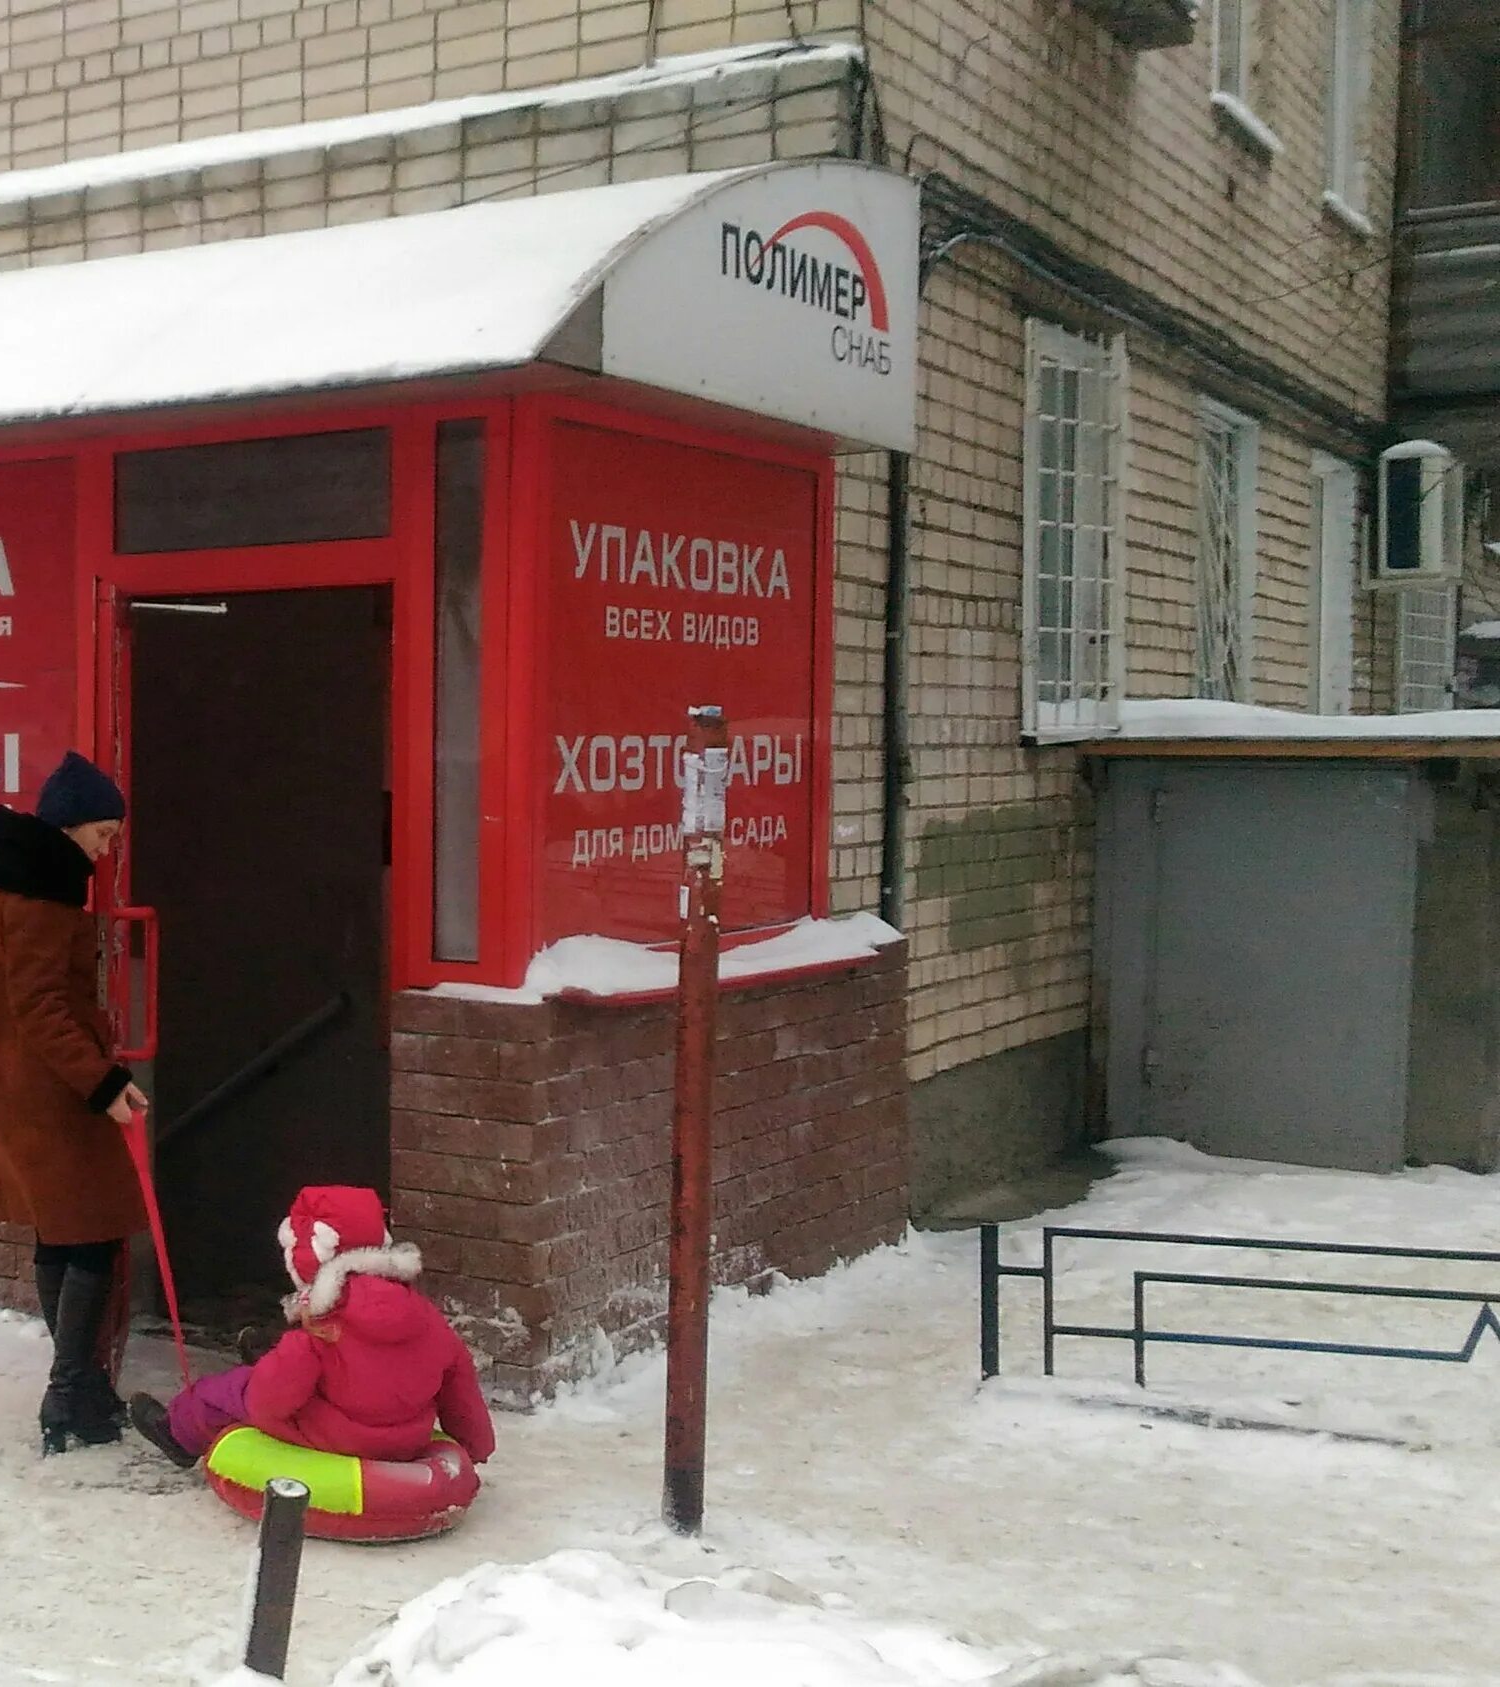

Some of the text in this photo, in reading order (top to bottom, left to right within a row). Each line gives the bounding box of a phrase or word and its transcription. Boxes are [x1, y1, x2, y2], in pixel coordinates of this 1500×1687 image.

[721, 221, 866, 321] ПОЛИМЕР
[831, 325, 892, 376] СНАБ
[569, 519, 791, 600] УПАКОВКА
[604, 605, 760, 650] ВСЕХ ВИДОВ
[553, 733, 801, 794] ХОЗТОАРЫ
[572, 815, 787, 870] ДЛЯ ДОМ САДА
